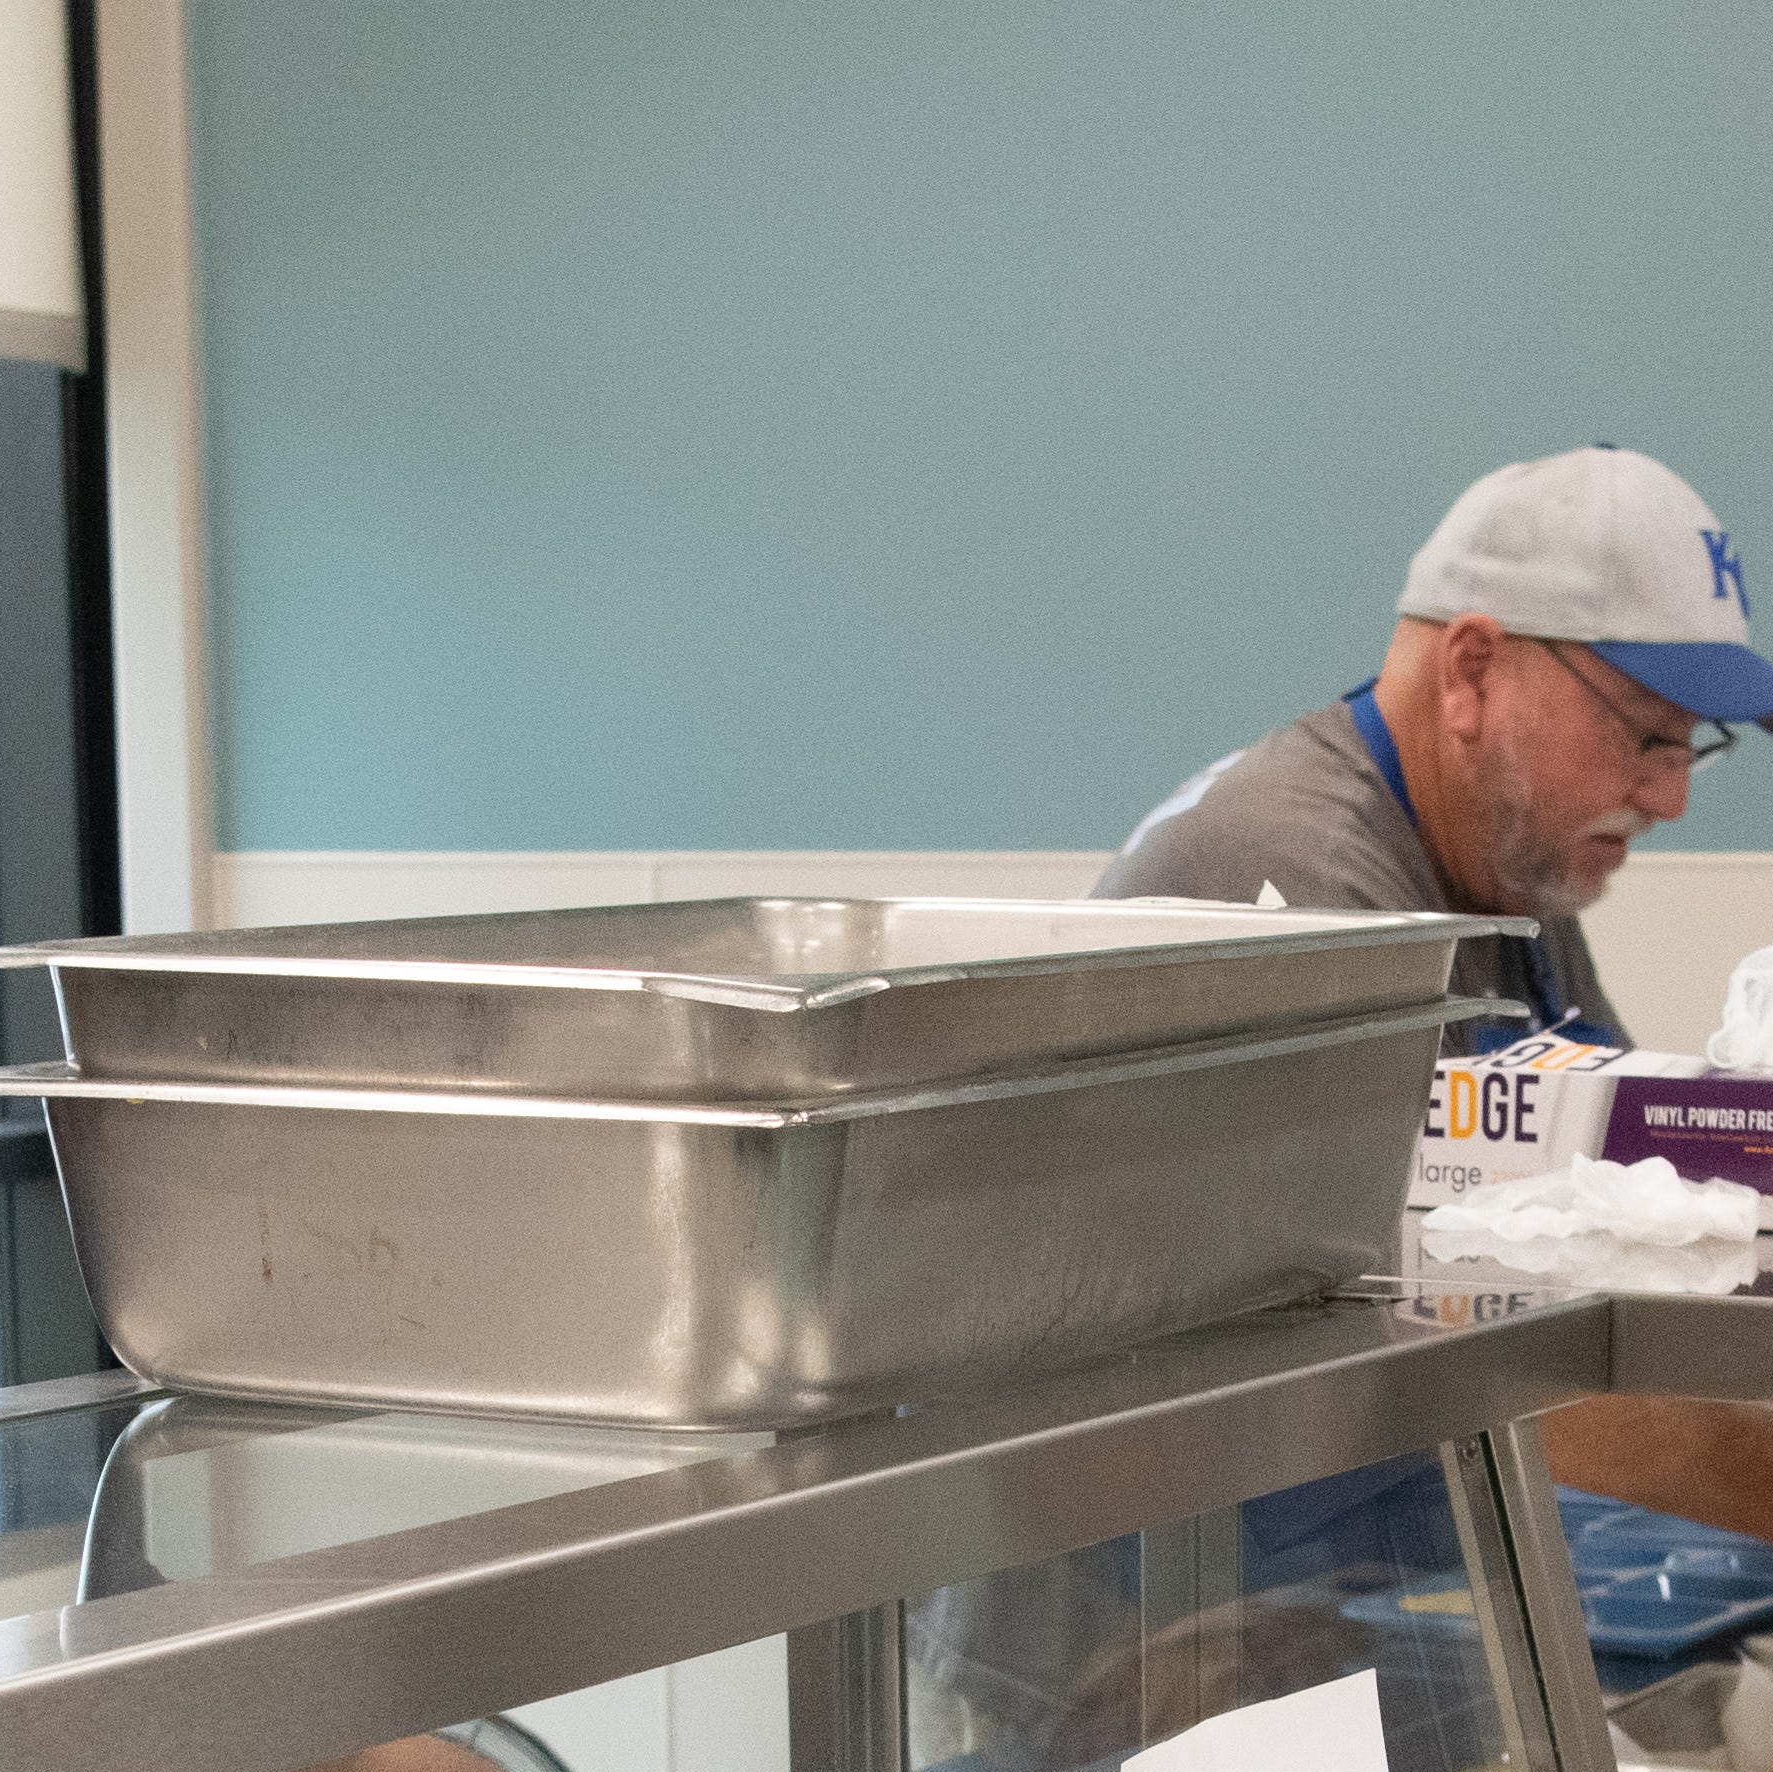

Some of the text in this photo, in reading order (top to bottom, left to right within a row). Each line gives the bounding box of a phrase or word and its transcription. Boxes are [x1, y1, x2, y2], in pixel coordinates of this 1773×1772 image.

[1644, 1105, 1686, 1127] VINYL
[1688, 1106, 1746, 1131] POWDER
[1419, 1152, 1482, 1193] large
